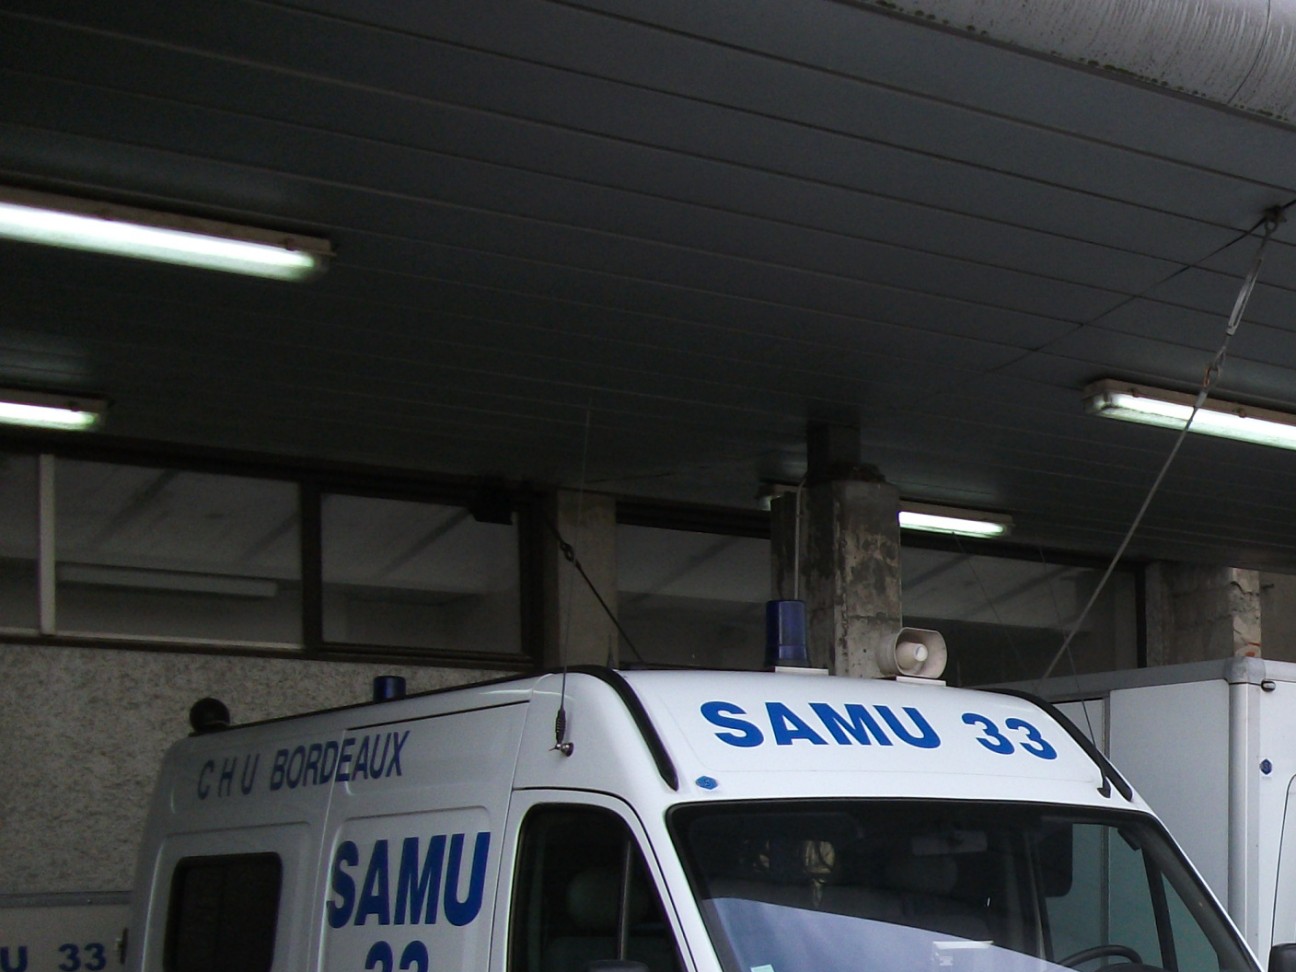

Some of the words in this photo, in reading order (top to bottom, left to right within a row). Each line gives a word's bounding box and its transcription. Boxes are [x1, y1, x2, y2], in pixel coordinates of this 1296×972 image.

[270, 730, 410, 791] BORDEAUX
[700, 701, 941, 748] SAMU
[961, 712, 1058, 760] 33
[326, 832, 491, 929] SAMU
[58, 942, 107, 972] 33
